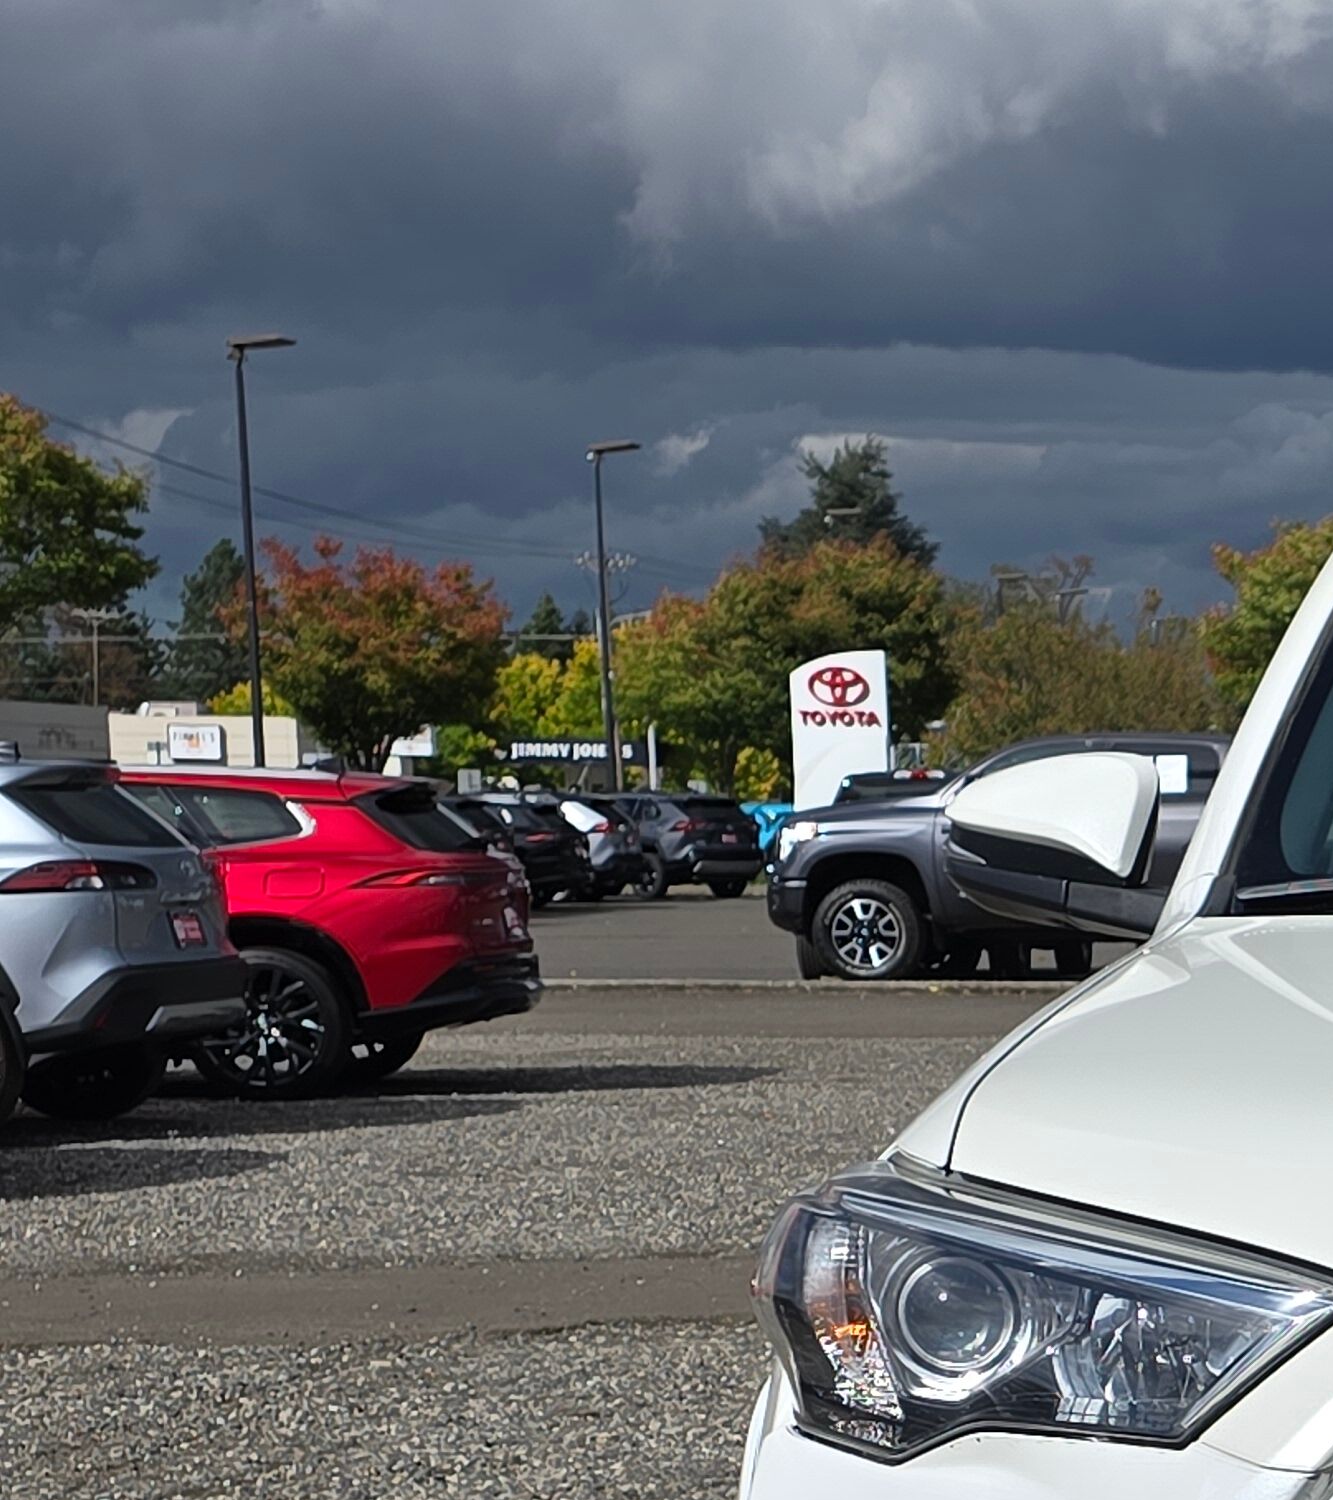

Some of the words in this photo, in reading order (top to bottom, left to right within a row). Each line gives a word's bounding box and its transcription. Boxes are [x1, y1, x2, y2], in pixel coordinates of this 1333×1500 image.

[799, 709, 882, 728] TOYOTA
[510, 742, 570, 760] JIMMY
[573, 742, 633, 760] JOHS
